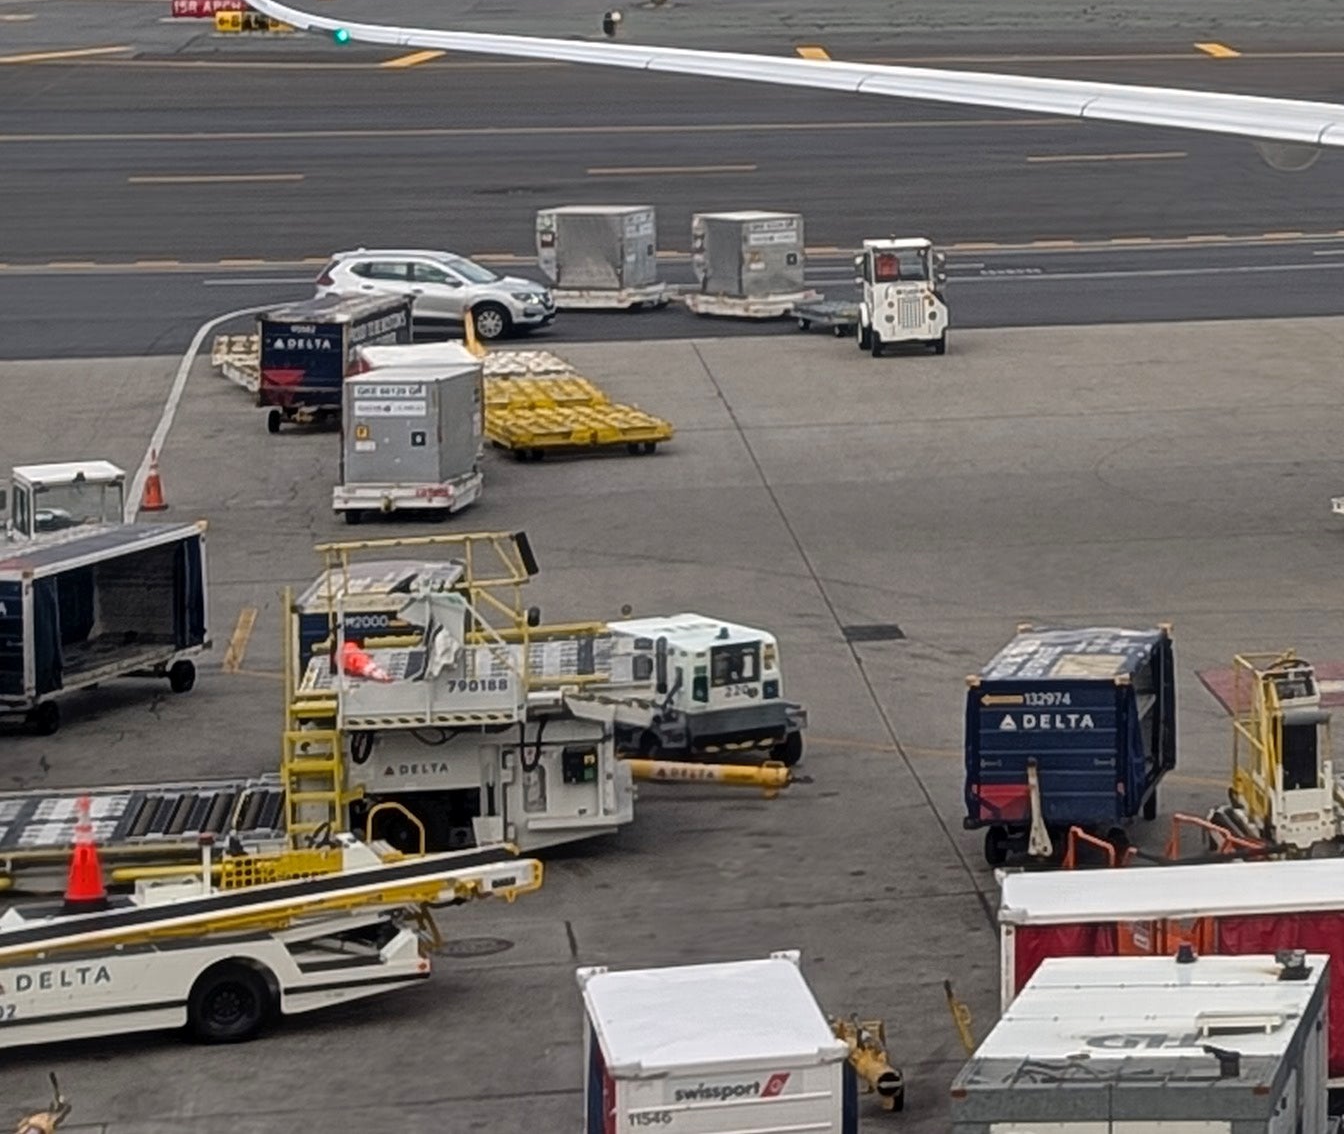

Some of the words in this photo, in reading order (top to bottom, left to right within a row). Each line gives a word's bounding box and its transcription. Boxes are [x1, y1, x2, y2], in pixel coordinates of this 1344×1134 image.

[287, 339, 331, 350] DELTA
[1024, 692, 1071, 706] 132974
[1023, 714, 1095, 729] DELTA
[400, 764, 449, 776] DELTA
[16, 966, 111, 992] DELTA
[675, 1080, 761, 1103] swissport
